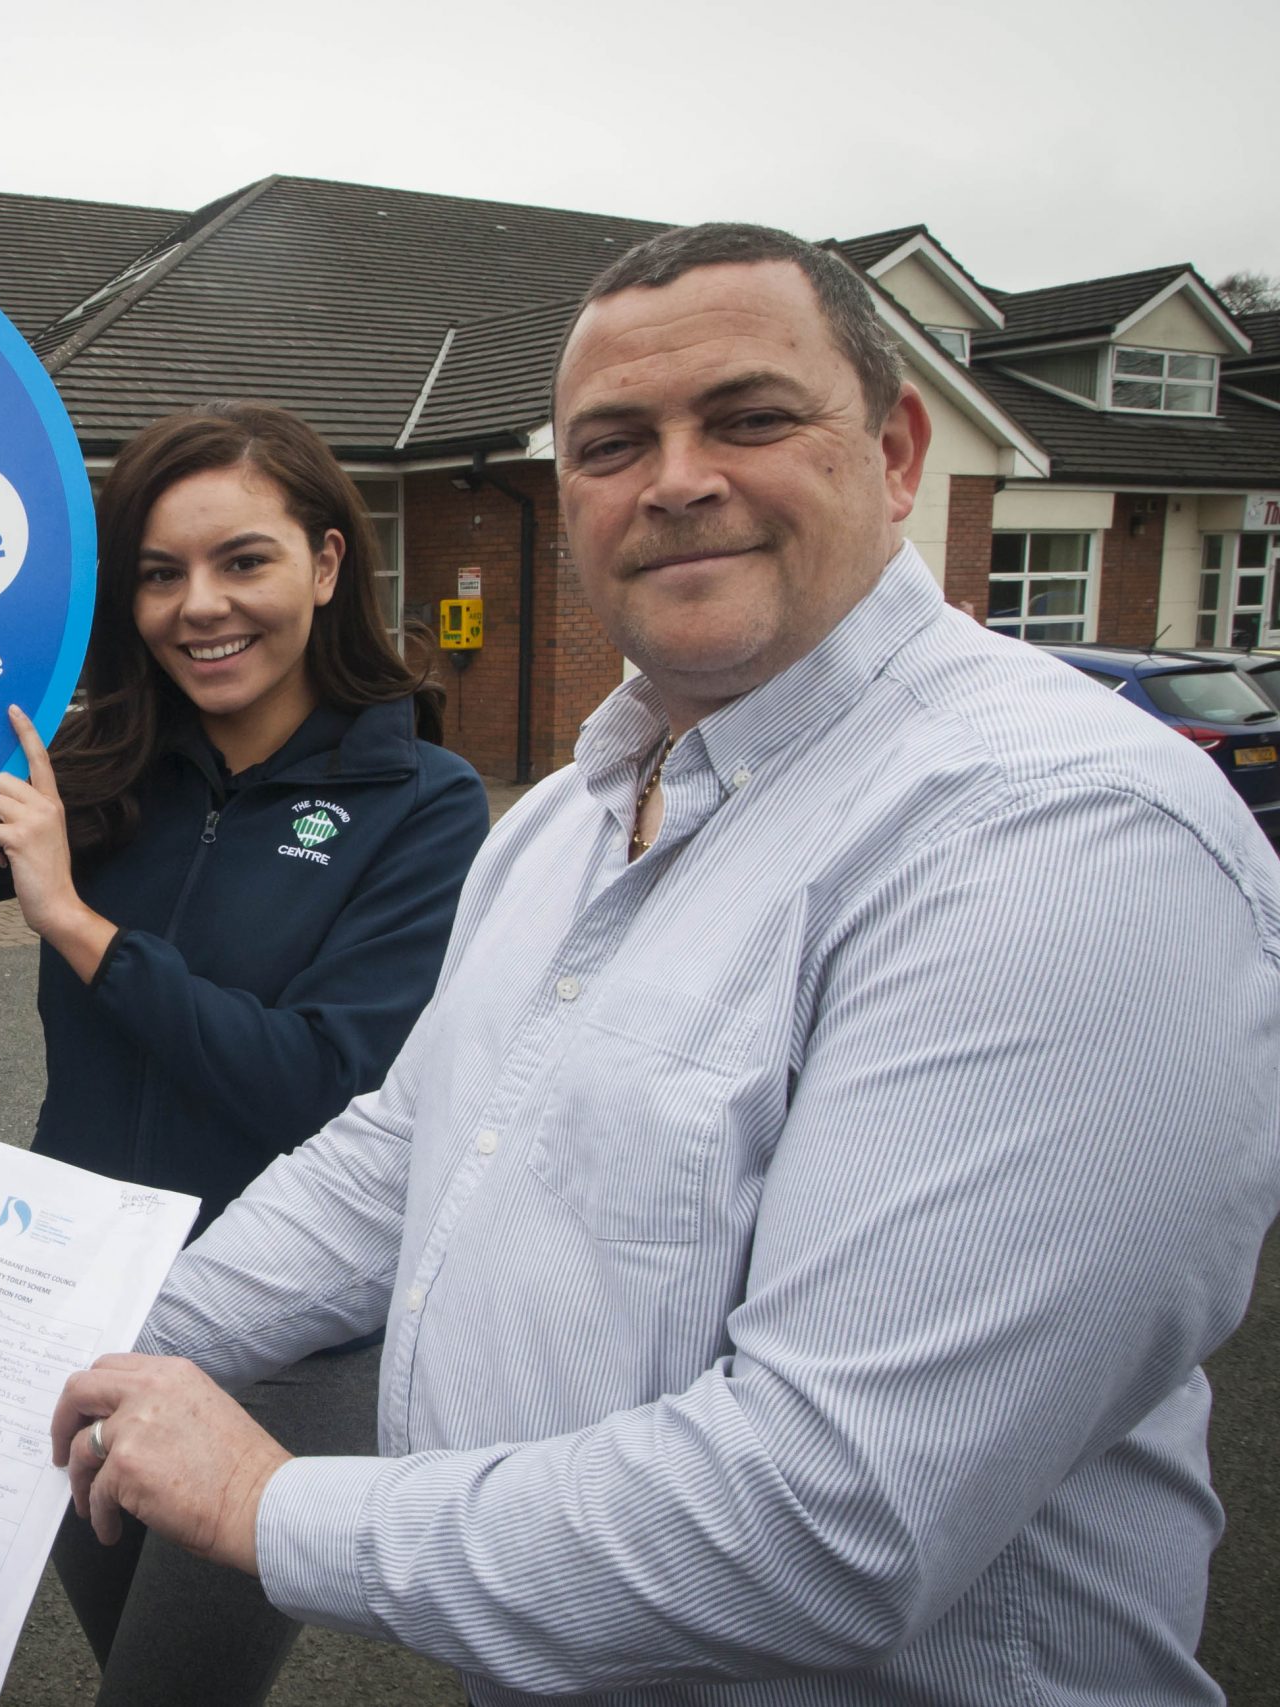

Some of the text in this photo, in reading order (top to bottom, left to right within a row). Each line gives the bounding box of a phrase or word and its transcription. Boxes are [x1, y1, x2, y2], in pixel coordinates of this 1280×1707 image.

[291, 800, 350, 823] THE DIAMOND
[278, 845, 331, 865] CENTRE
[7, 1274, 26, 1288] TOILET
[27, 1280, 52, 1295] SCHEME
[24, 1266, 50, 1280] DISTRICT
[52, 1274, 77, 1288] COUNCIL
[14, 1290, 33, 1304] FORM
